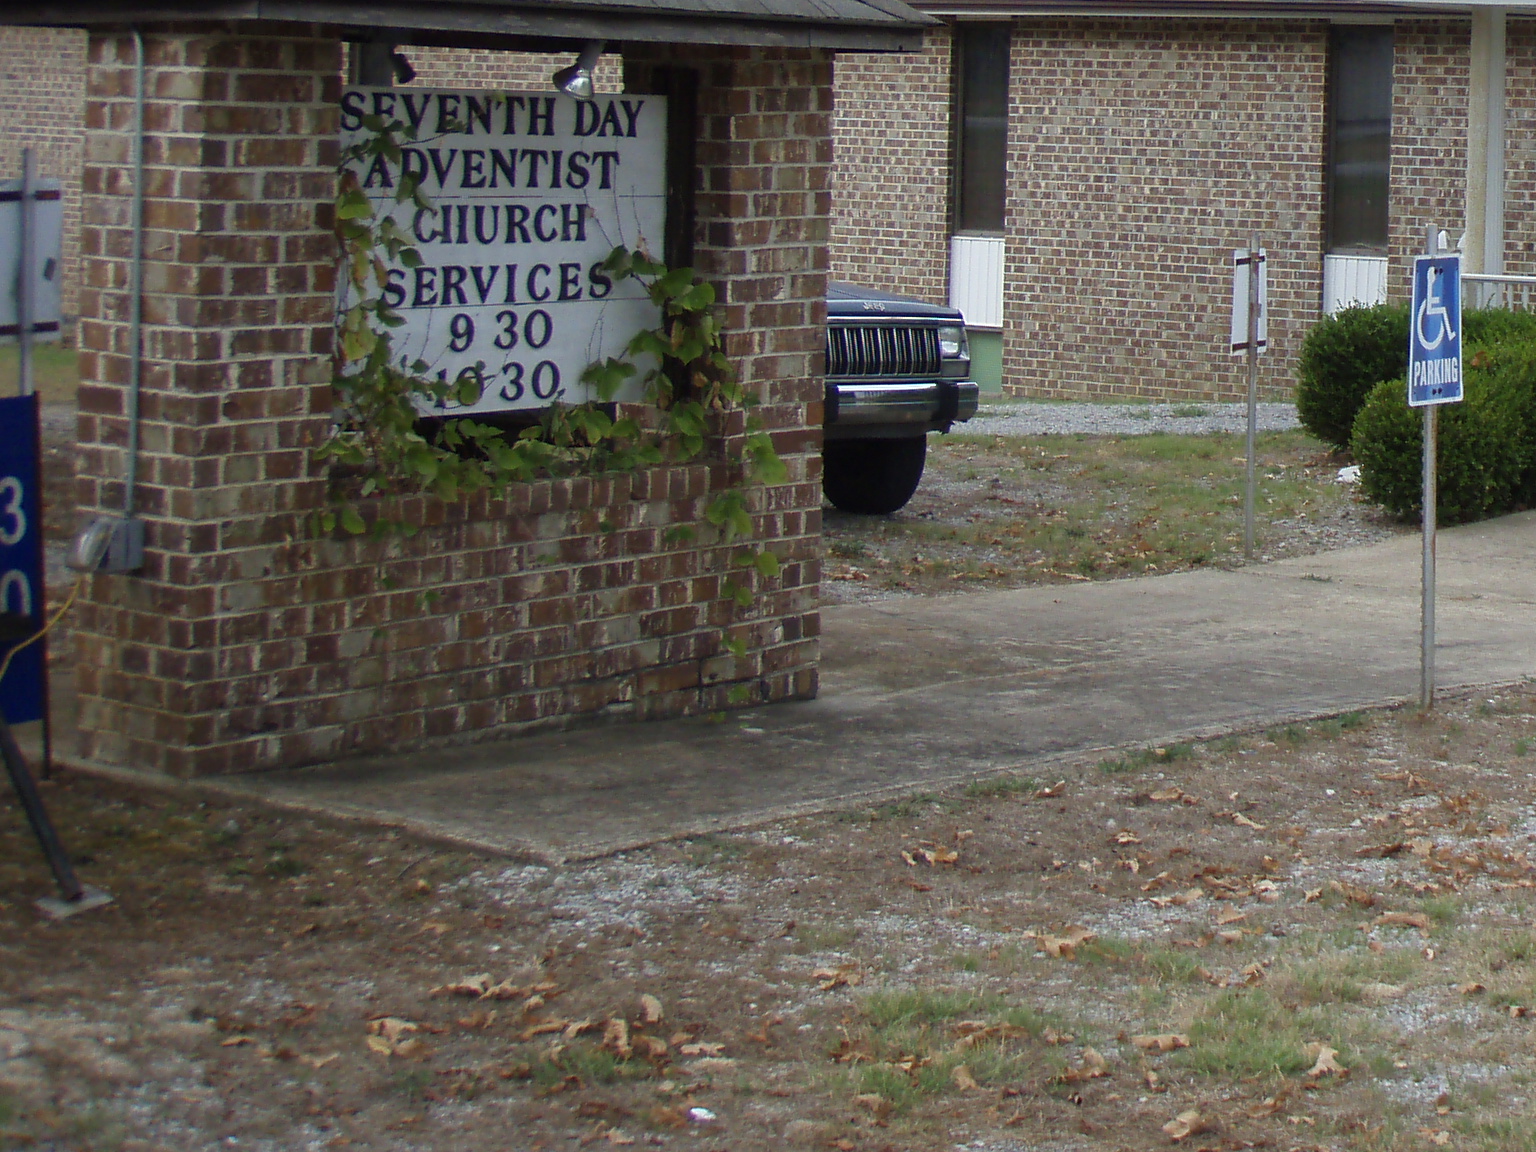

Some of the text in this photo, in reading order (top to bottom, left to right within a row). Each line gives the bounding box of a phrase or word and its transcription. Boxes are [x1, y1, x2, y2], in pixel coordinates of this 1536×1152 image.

[340, 91, 645, 138] SEVENTH DAY
[364, 148, 620, 190] ADVENTIST
[414, 203, 588, 245] CHURCH
[382, 262, 613, 308] SERVICES
[450, 309, 553, 352] 9 30
[500, 360, 561, 401] 30
[1413, 358, 1458, 386] PARKING
